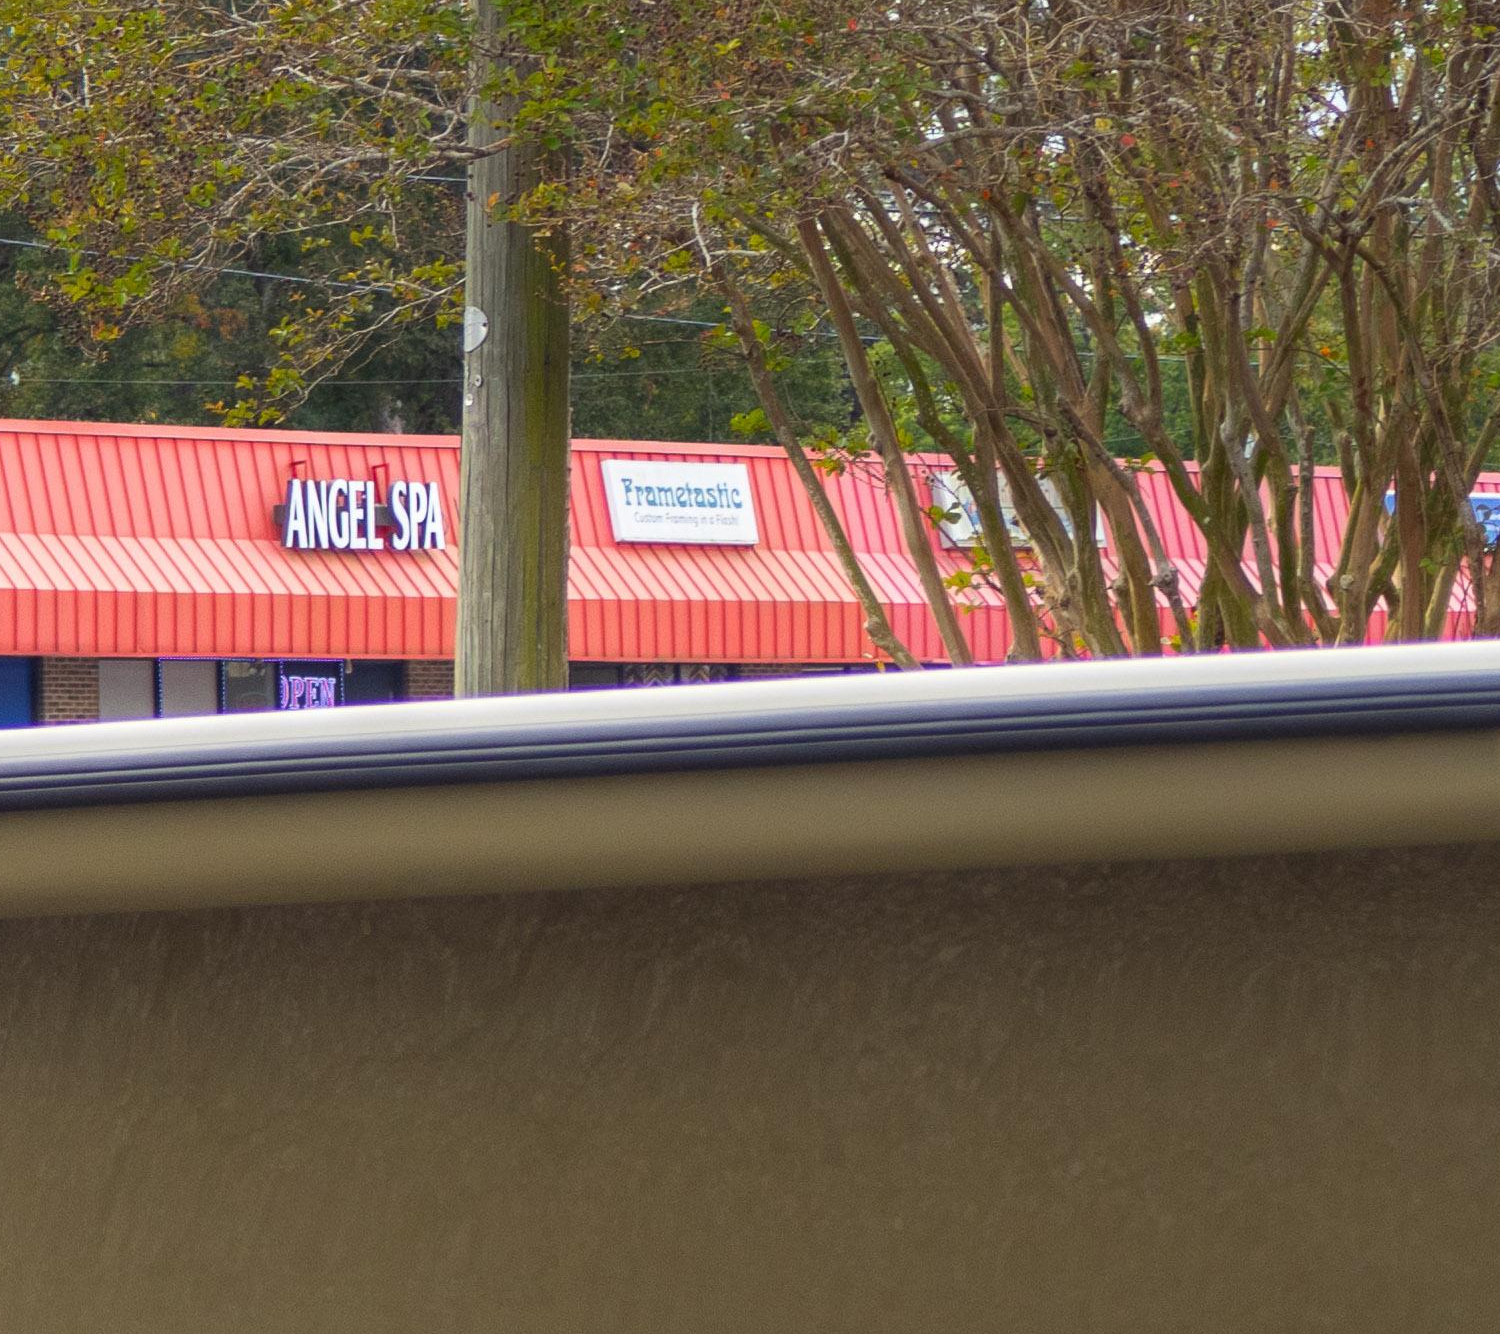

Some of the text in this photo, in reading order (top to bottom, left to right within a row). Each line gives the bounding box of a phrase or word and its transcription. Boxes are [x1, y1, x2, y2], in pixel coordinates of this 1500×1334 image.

[286, 478, 446, 550] ANGEL SPA
[621, 478, 743, 509] Frametastic
